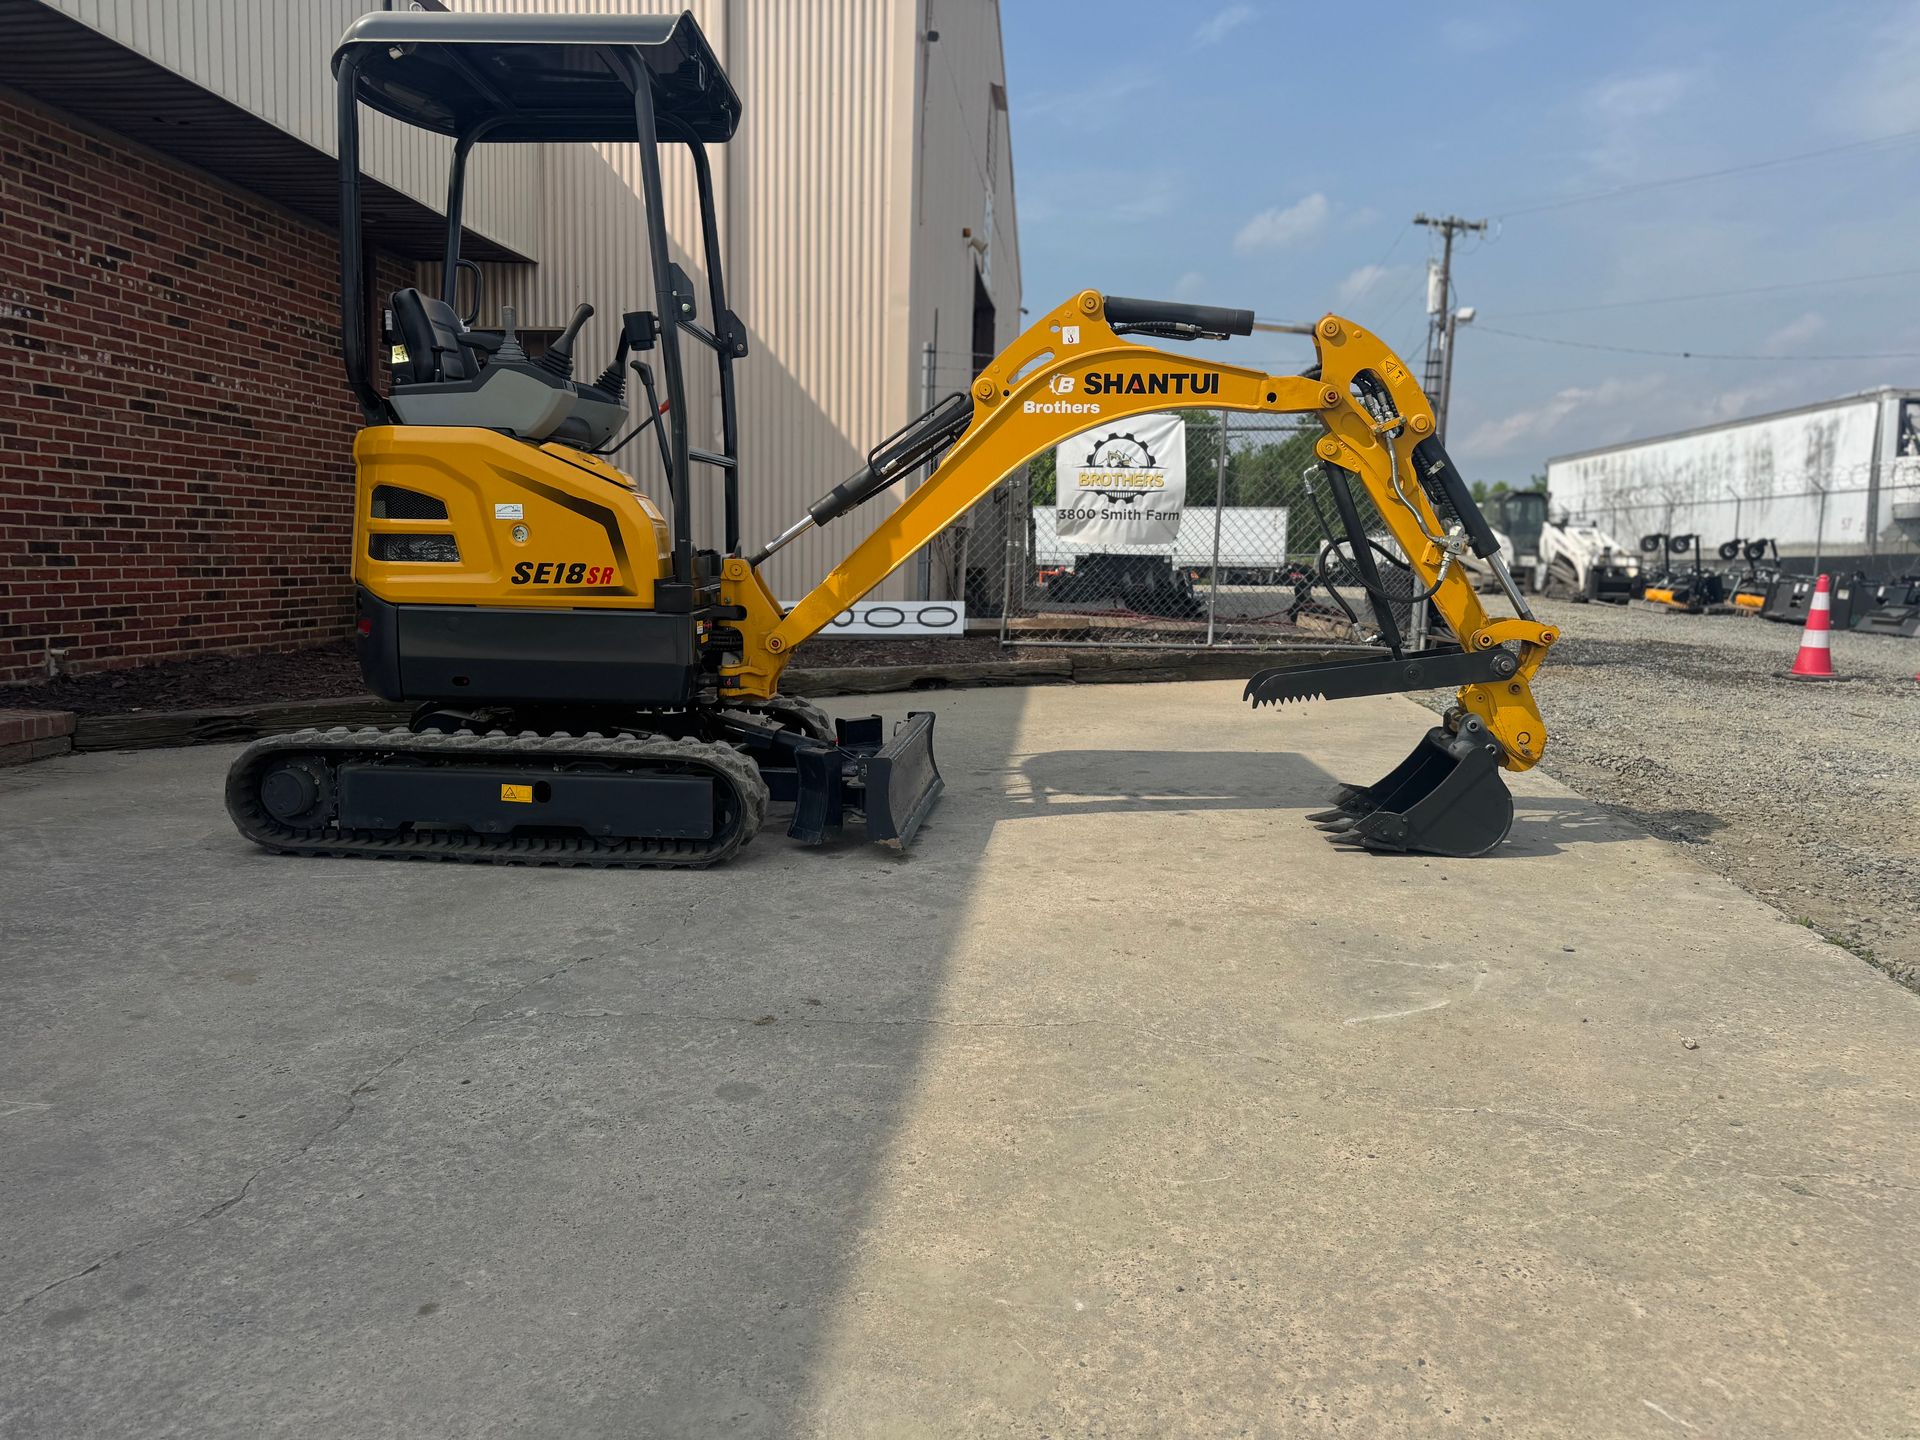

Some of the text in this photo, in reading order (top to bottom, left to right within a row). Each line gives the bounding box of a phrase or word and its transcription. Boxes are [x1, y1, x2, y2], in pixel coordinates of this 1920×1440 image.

[1084, 372, 1219, 395] SHANTUI
[1023, 400, 1100, 414] Brothers
[1079, 473, 1165, 488] BROTHERS
[1058, 508, 1180, 521] 3800 Smith Farm
